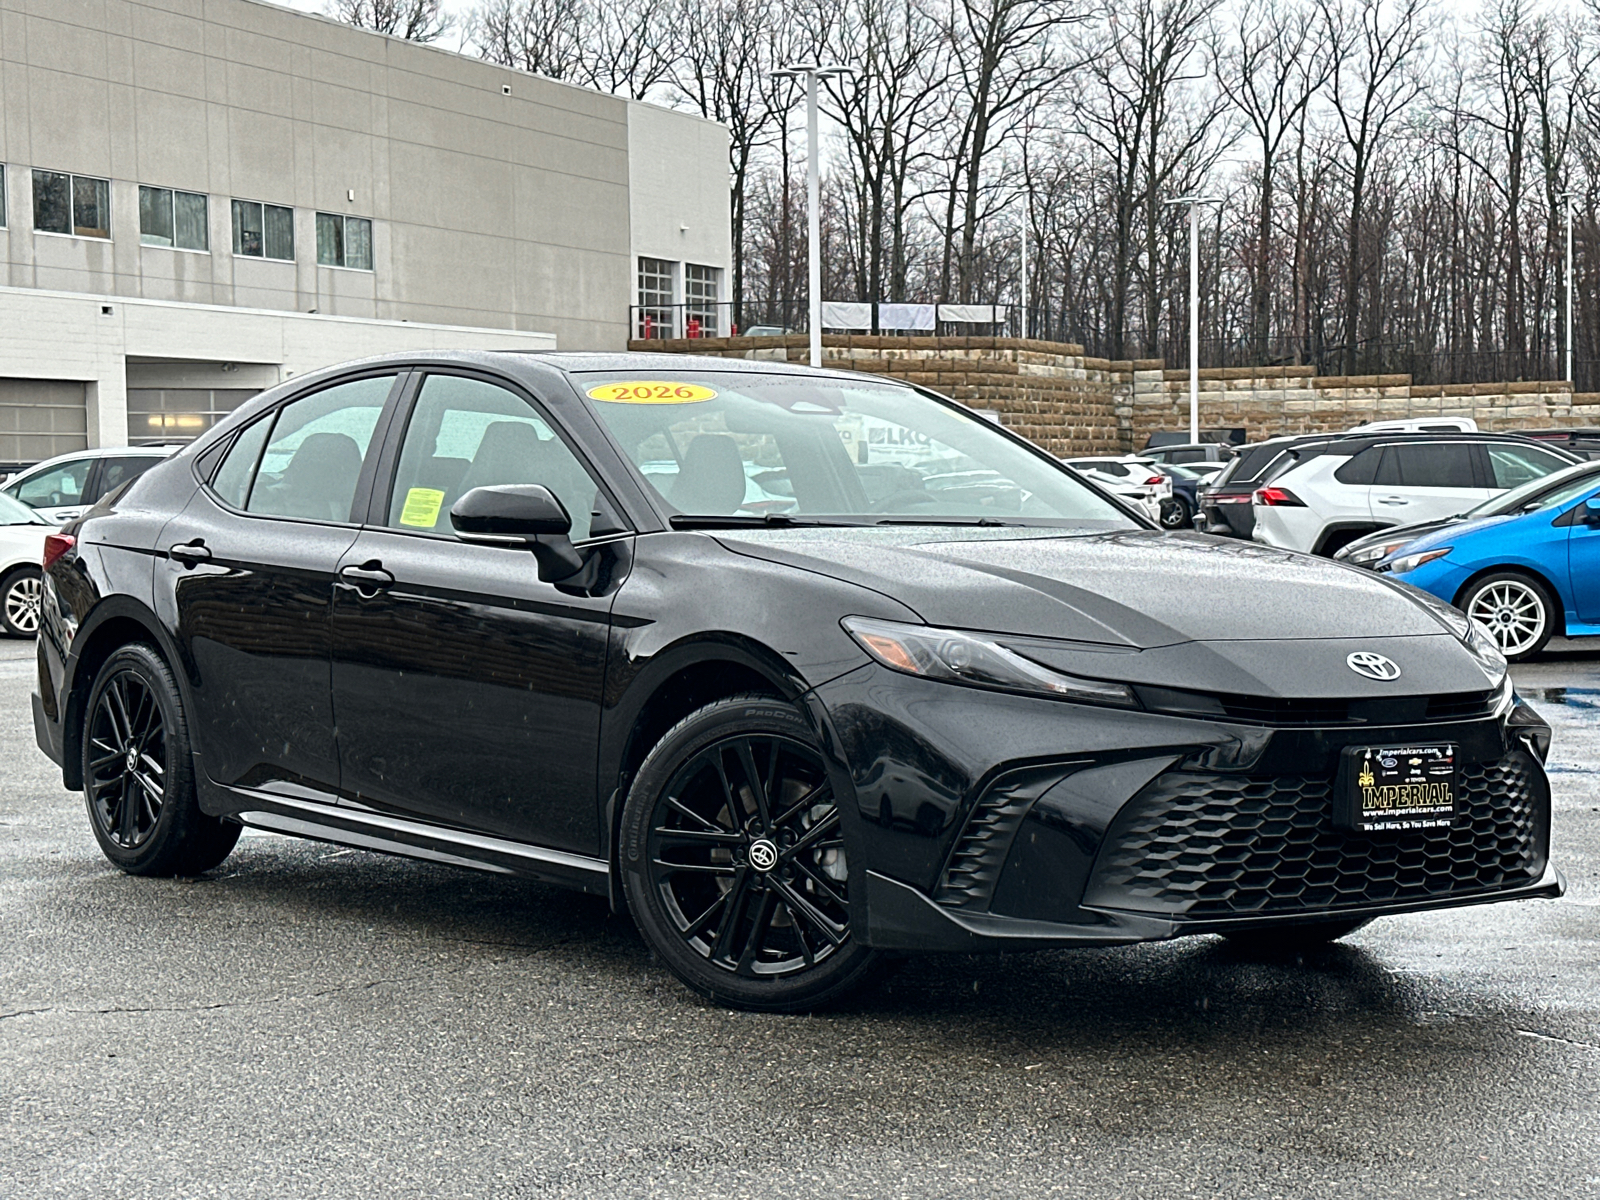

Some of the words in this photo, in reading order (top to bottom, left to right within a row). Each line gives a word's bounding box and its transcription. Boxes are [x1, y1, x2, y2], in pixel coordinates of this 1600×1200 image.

[612, 386, 694, 400] 2026
[887, 427, 931, 446] LKQ
[1363, 783, 1453, 809] IMPERIAL
[1362, 806, 1453, 817] www.imperialcars.com
[1364, 823, 1373, 831] We
[1374, 822, 1385, 831] Sell
[1402, 821, 1410, 829] So
